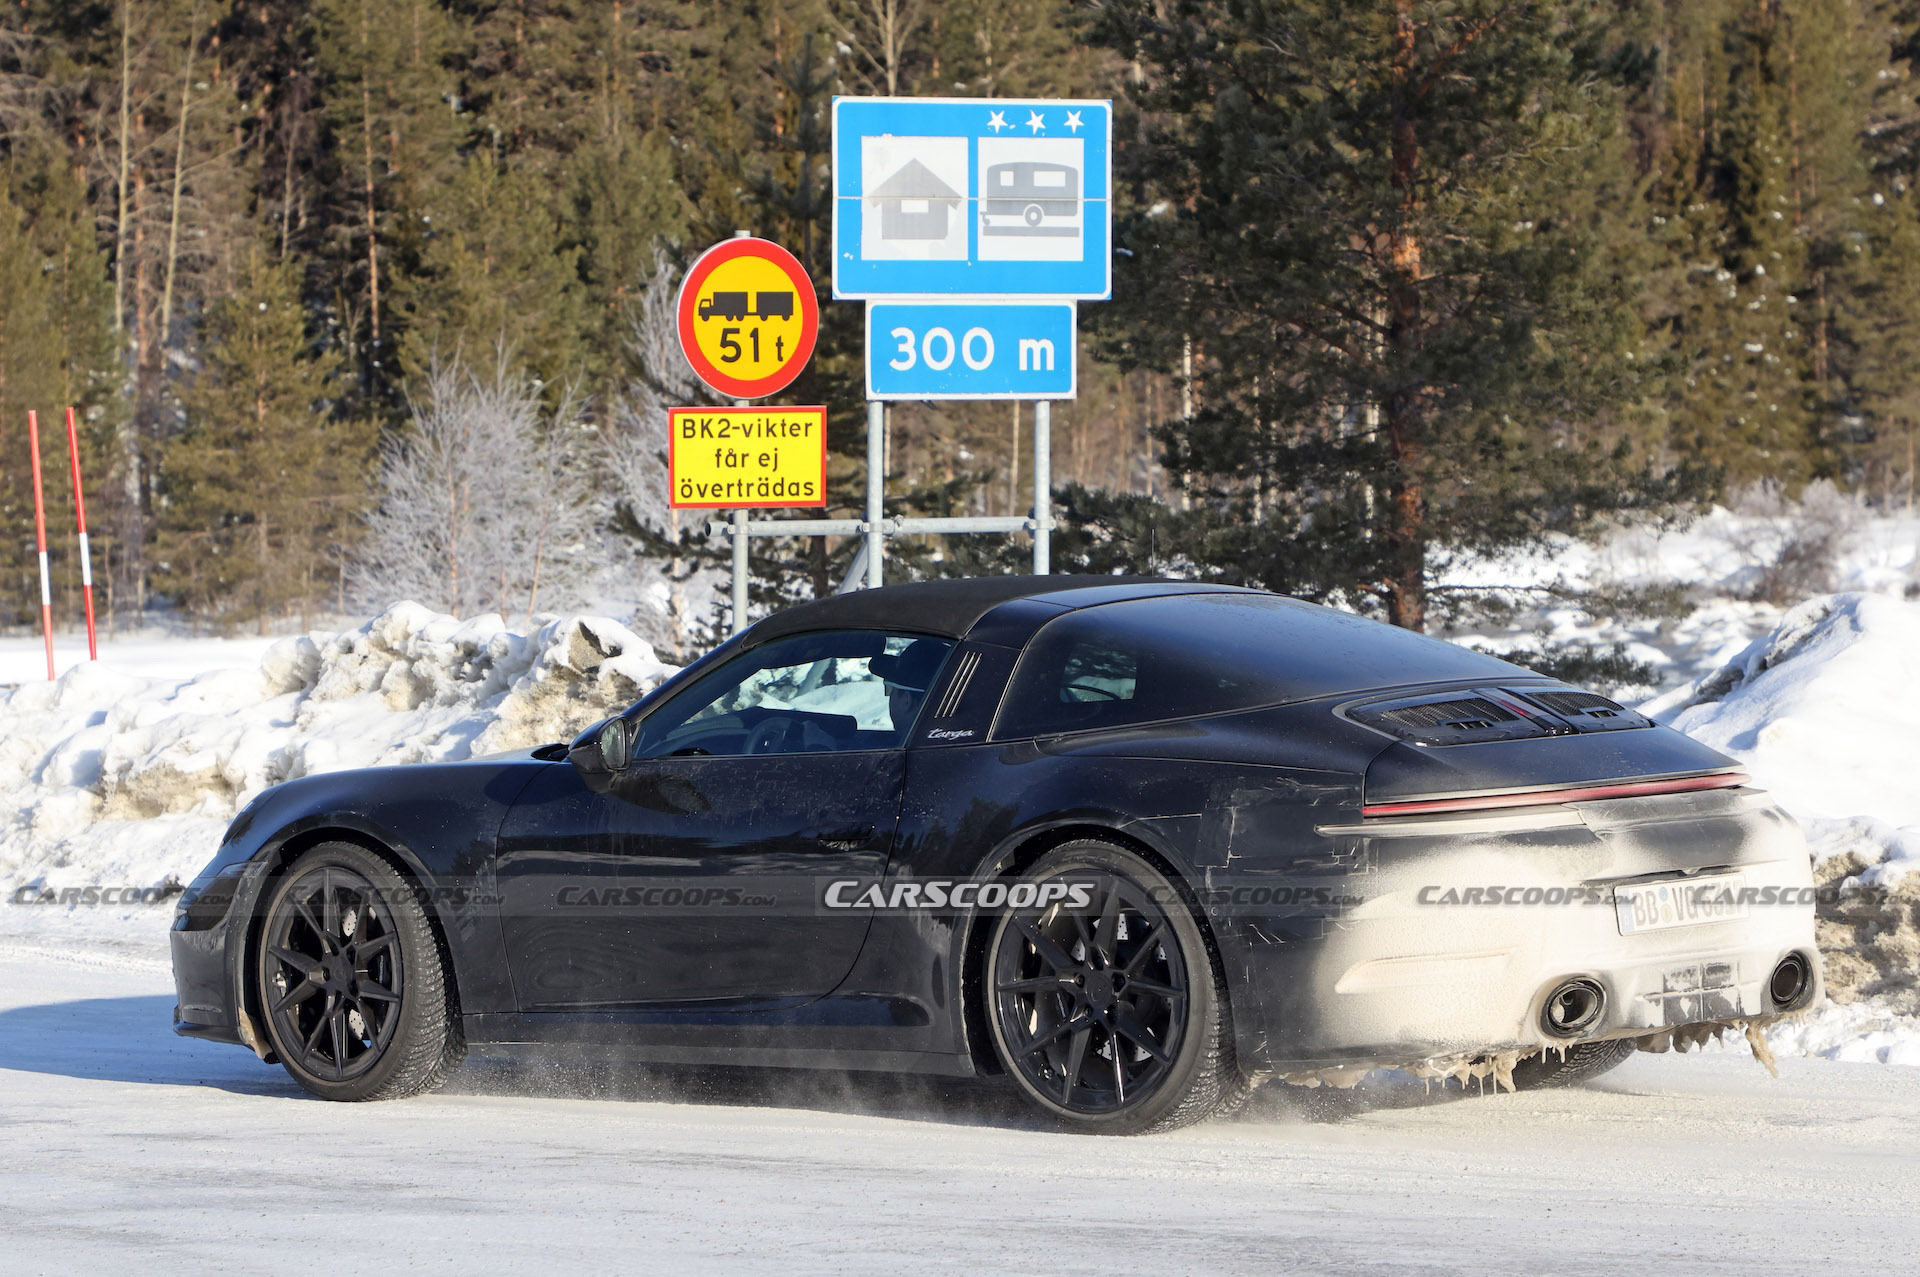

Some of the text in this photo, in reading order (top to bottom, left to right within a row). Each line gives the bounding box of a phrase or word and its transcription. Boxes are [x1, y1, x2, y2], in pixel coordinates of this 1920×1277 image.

[719, 327, 784, 363] 51 t
[889, 326, 1055, 371] 300 m
[682, 418, 813, 439] BK2-vikter
[715, 447, 779, 472] får ej
[680, 477, 814, 497] överträdas
[927, 728, 974, 741] targa
